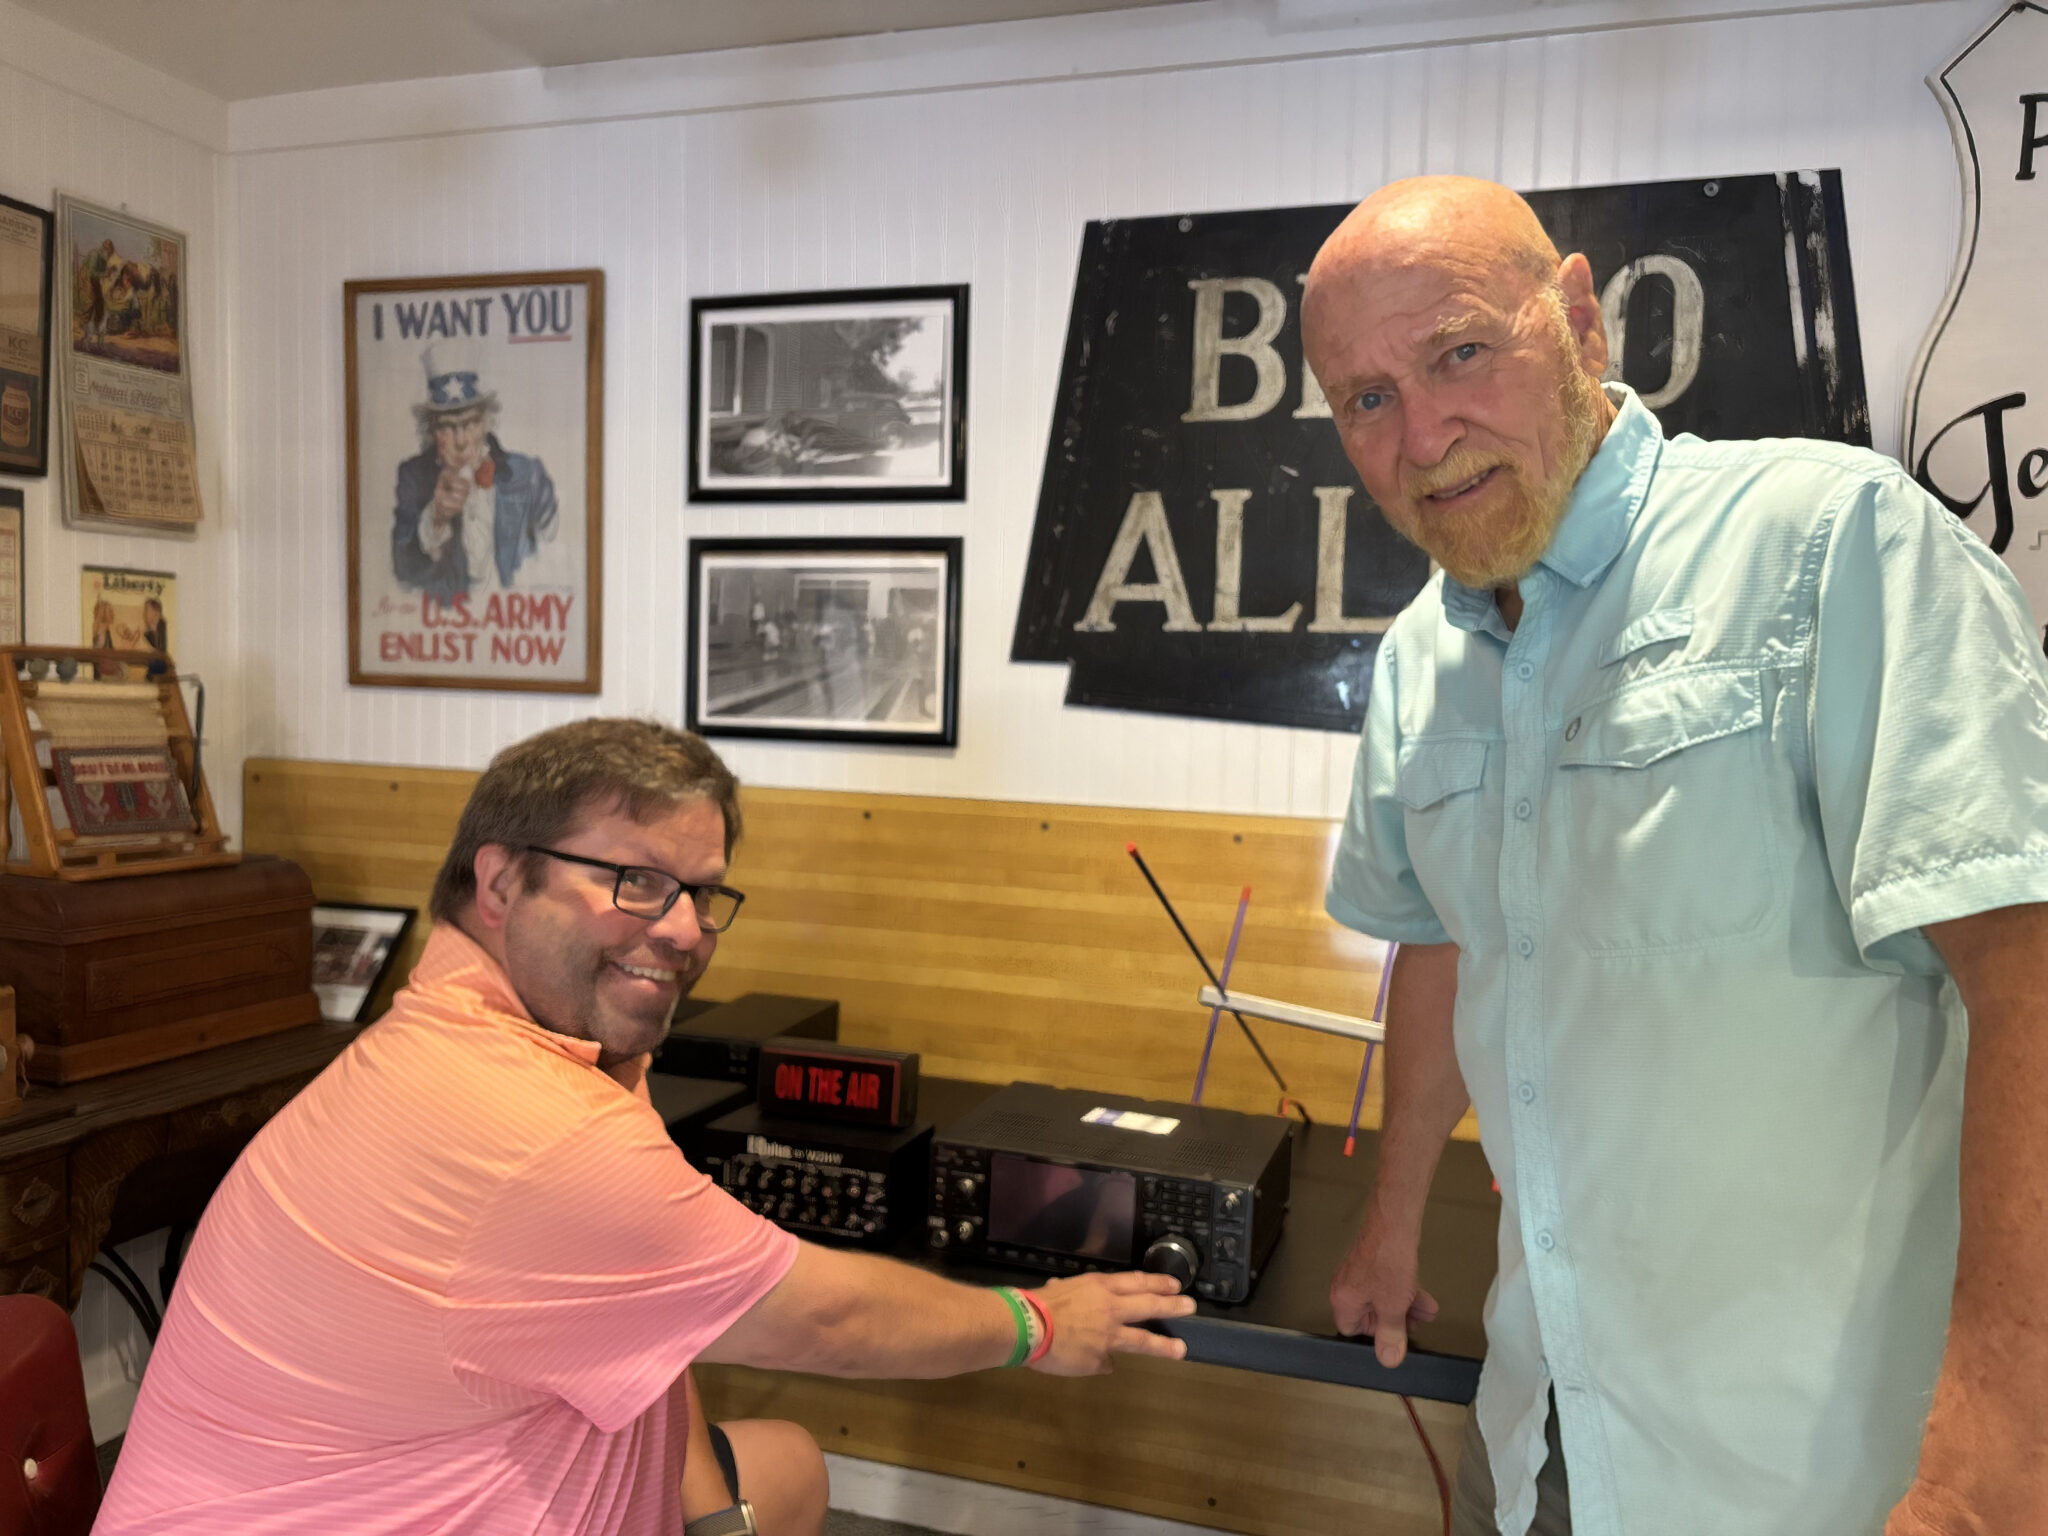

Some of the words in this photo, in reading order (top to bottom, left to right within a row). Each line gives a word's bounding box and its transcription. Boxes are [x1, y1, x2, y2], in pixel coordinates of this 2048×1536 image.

[373, 302, 384, 341] I
[394, 297, 493, 340] WANT
[501, 287, 572, 335] YOU
[103, 573, 165, 595] Liberty
[483, 593, 573, 631] ARMY
[380, 632, 478, 663] ENLIST
[491, 635, 565, 666] NOW
[775, 1063, 803, 1101] ON
[808, 1066, 842, 1107] THE
[845, 1071, 880, 1110] AIR
